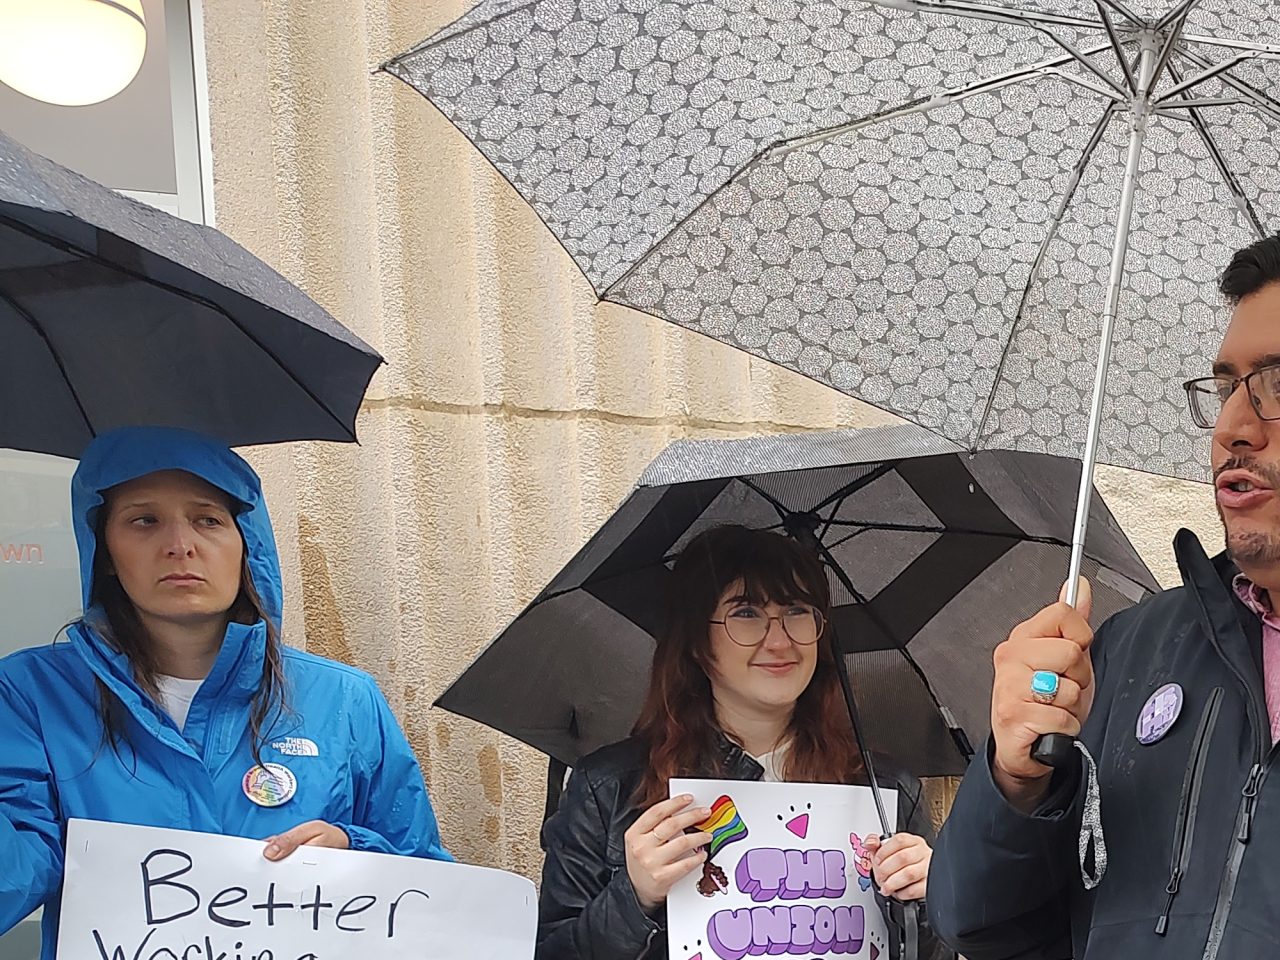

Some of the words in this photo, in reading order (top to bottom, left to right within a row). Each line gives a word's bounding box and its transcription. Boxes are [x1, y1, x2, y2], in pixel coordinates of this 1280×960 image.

[272, 742, 304, 750] NORTH
[140, 849, 430, 937] Better
[734, 848, 847, 902] THE
[707, 905, 864, 960] UNION
